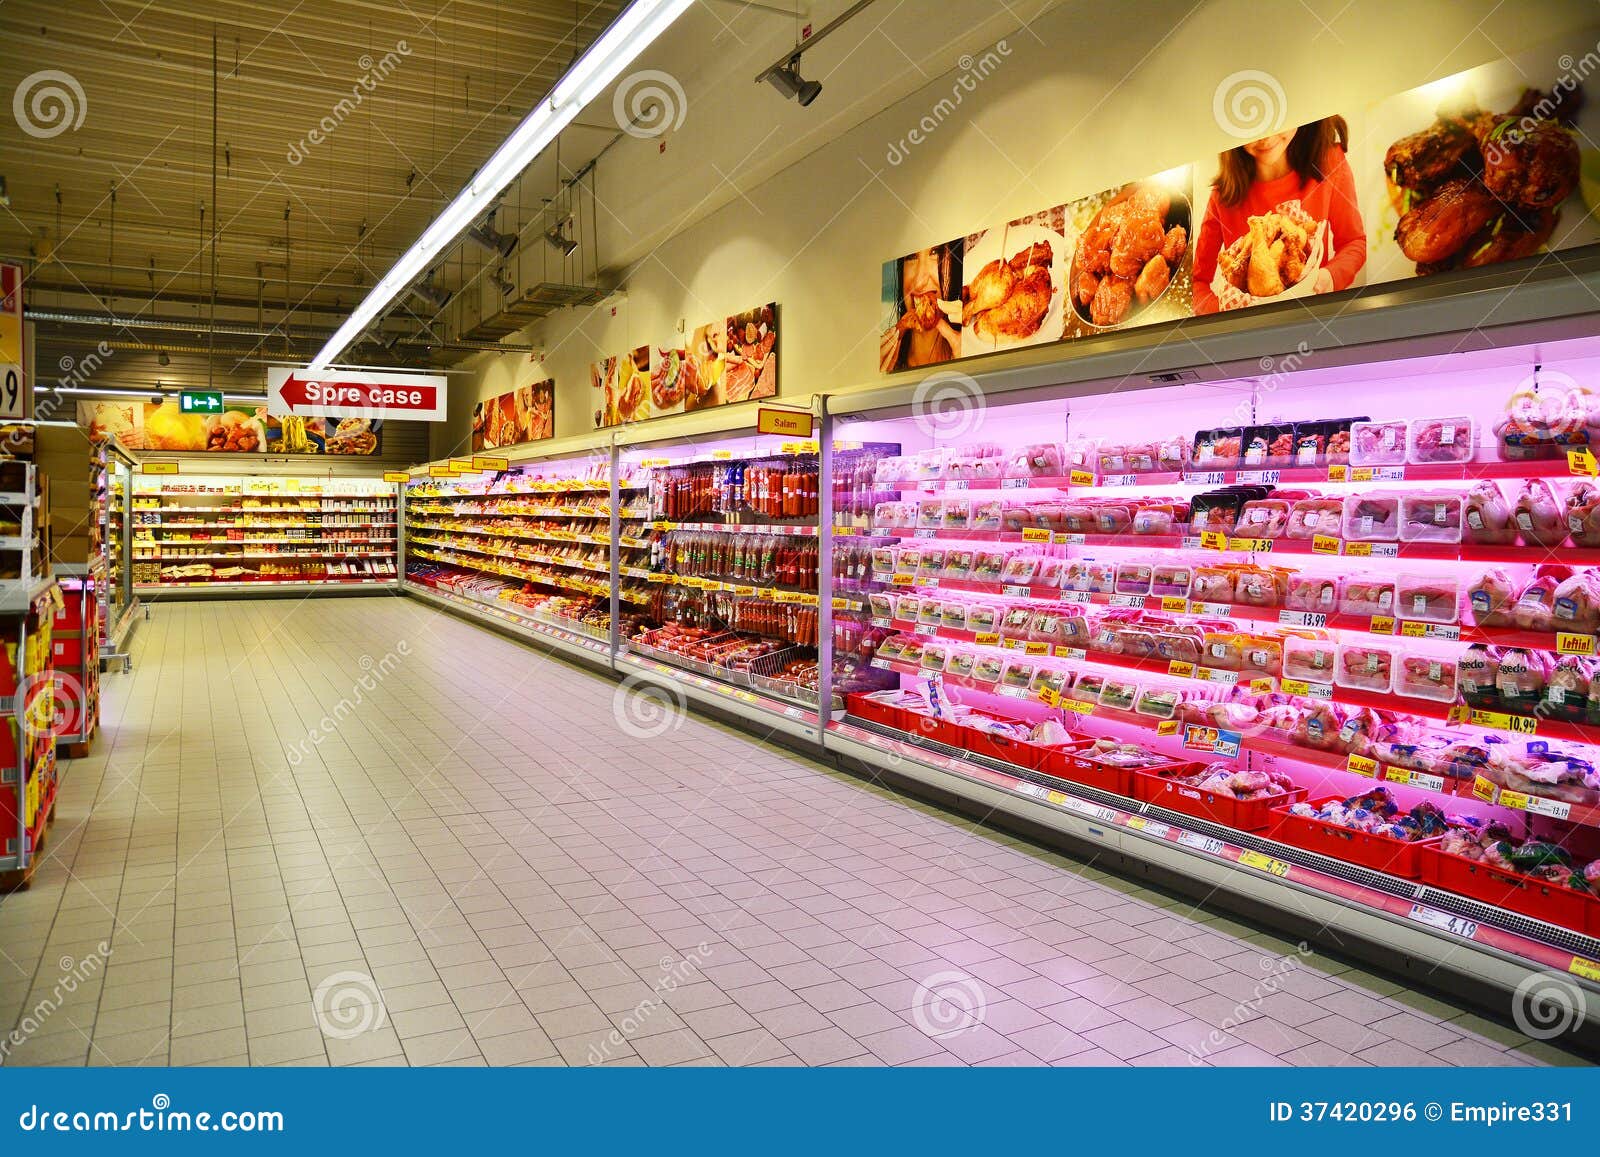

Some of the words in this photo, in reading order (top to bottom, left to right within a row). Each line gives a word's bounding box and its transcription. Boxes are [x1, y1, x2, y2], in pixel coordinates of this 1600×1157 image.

[305, 382, 360, 405] Spre
[369, 388, 422, 405] case
[774, 418, 797, 429] Salam
[1015, 478, 1028, 488] 22.99
[1208, 473, 1225, 484] 21.29
[1262, 472, 1279, 483] 15.99
[1252, 540, 1272, 552] 7.39
[1303, 613, 1325, 626] 13.99
[1509, 716, 1534, 733] 10.99
[1552, 806, 1568, 817] 13.19
[1203, 839, 1223, 854] 15.99
[1447, 917, 1476, 937] 4.19
